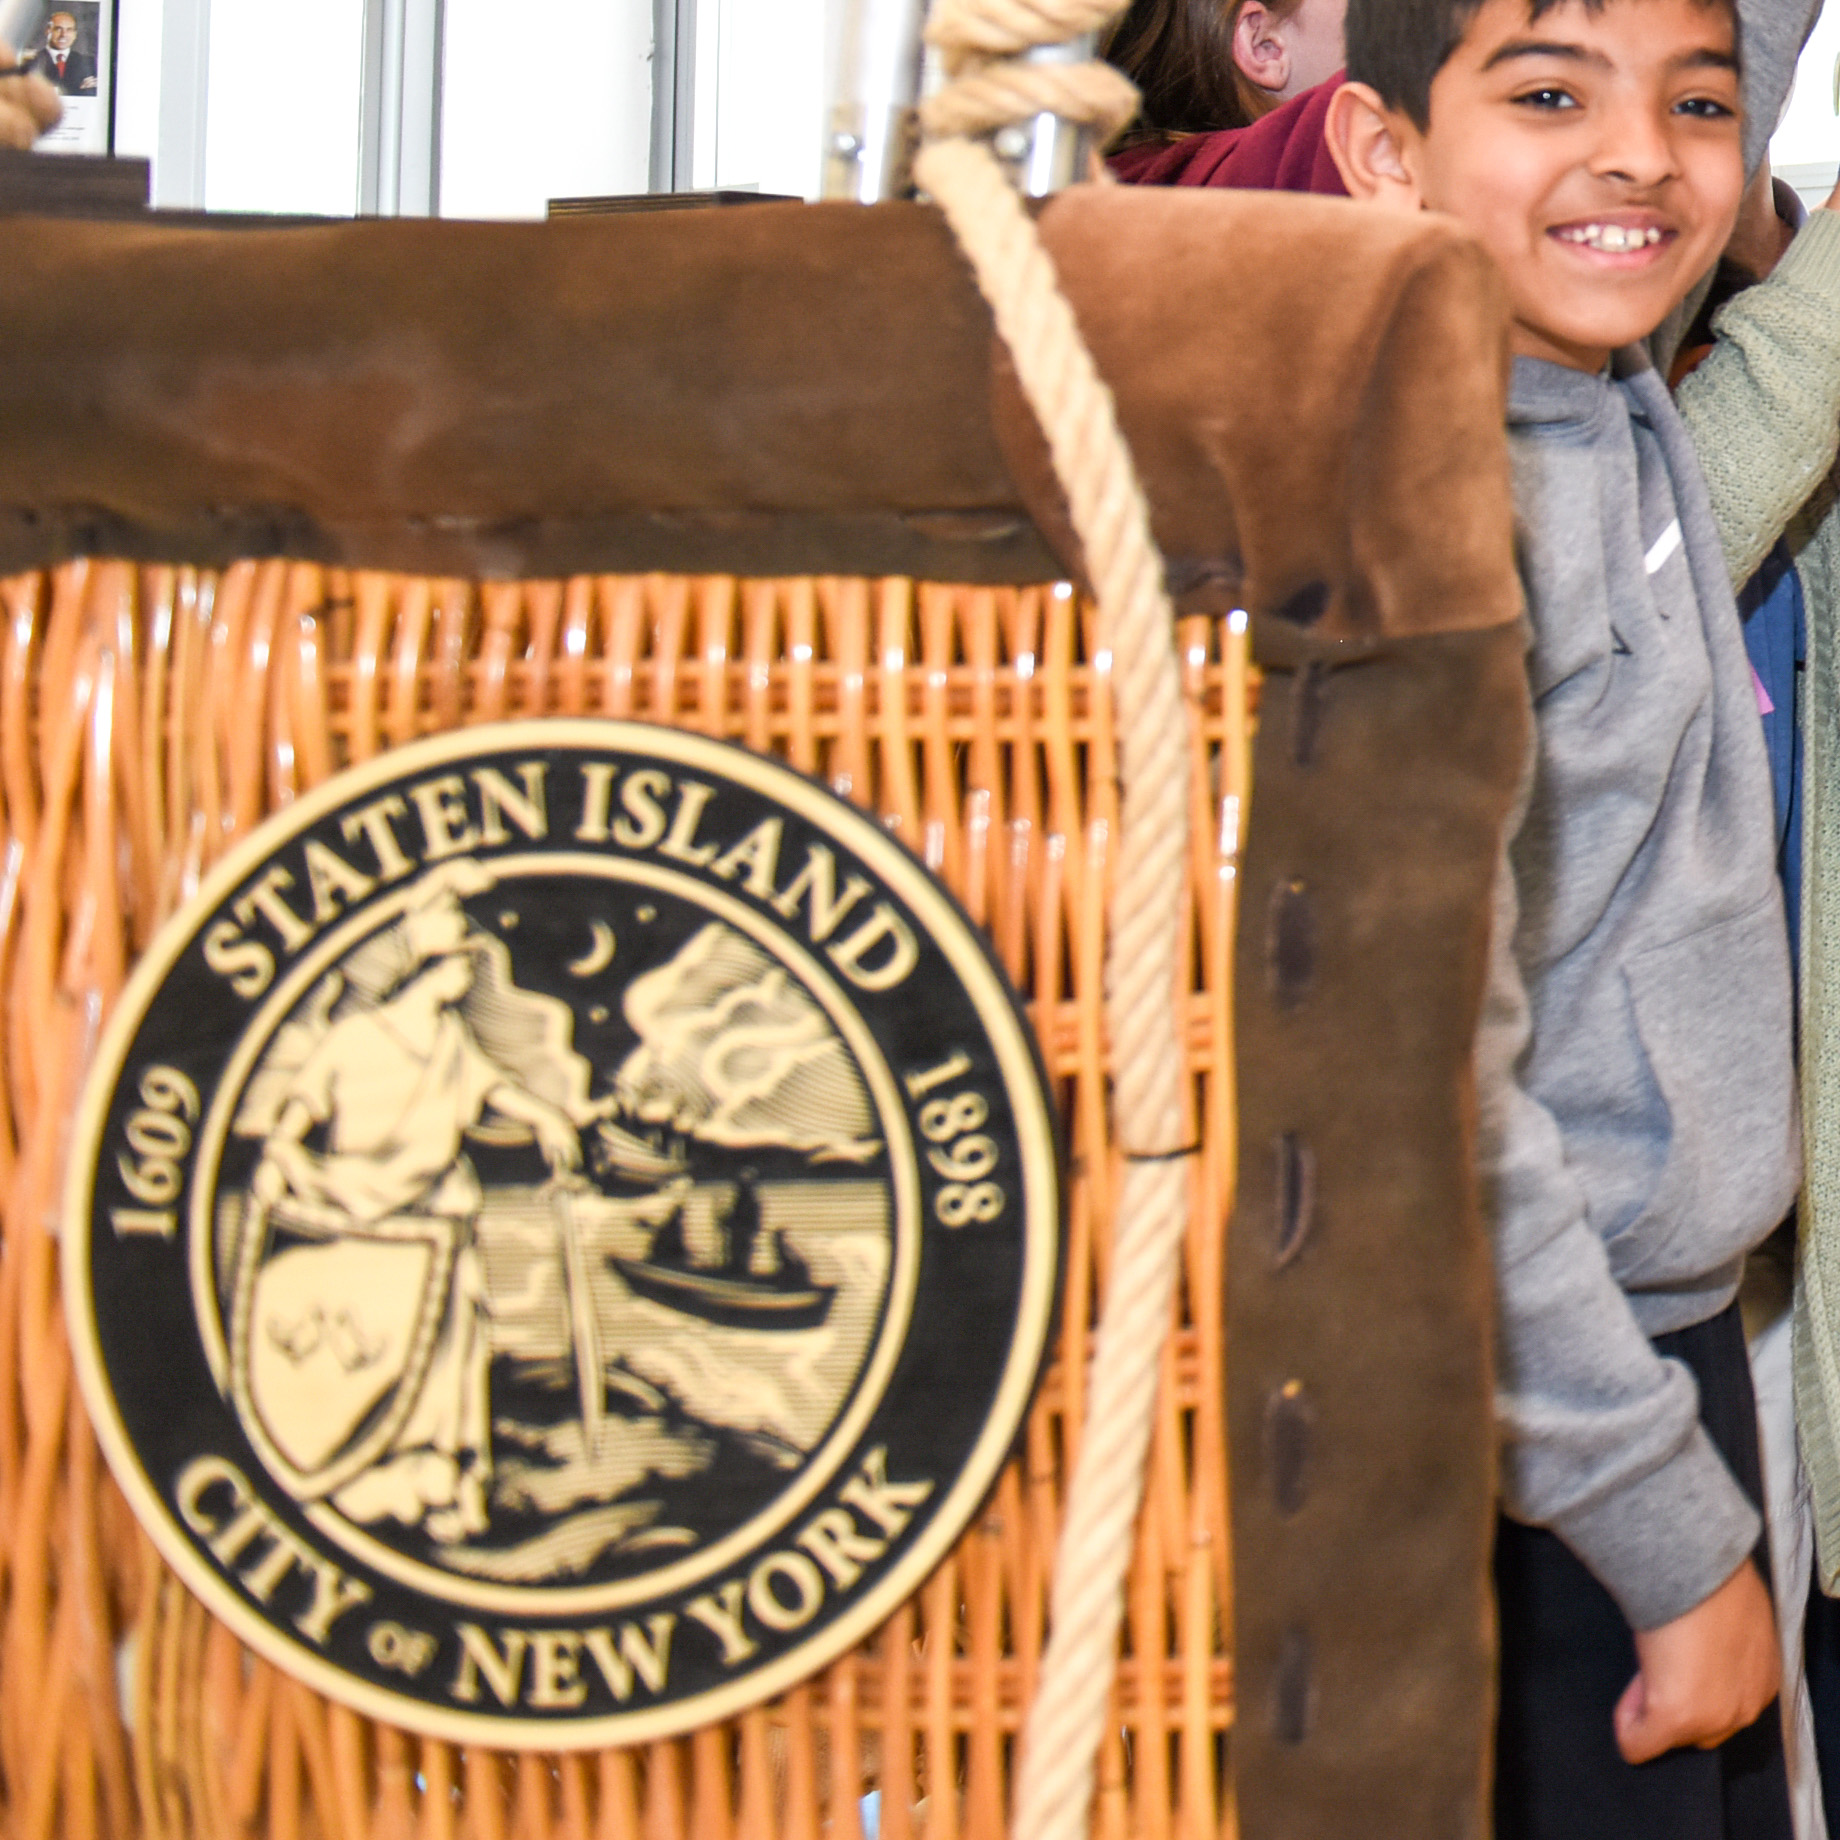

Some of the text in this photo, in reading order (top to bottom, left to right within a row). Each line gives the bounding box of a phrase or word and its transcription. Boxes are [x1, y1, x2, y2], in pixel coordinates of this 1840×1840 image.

[201, 761, 920, 1002] STATEN ISLAND
[112, 1064, 202, 1243] 1609
[905, 1050, 1005, 1230] 1898
[173, 1446, 936, 1710] CITY OF NEW YORK
